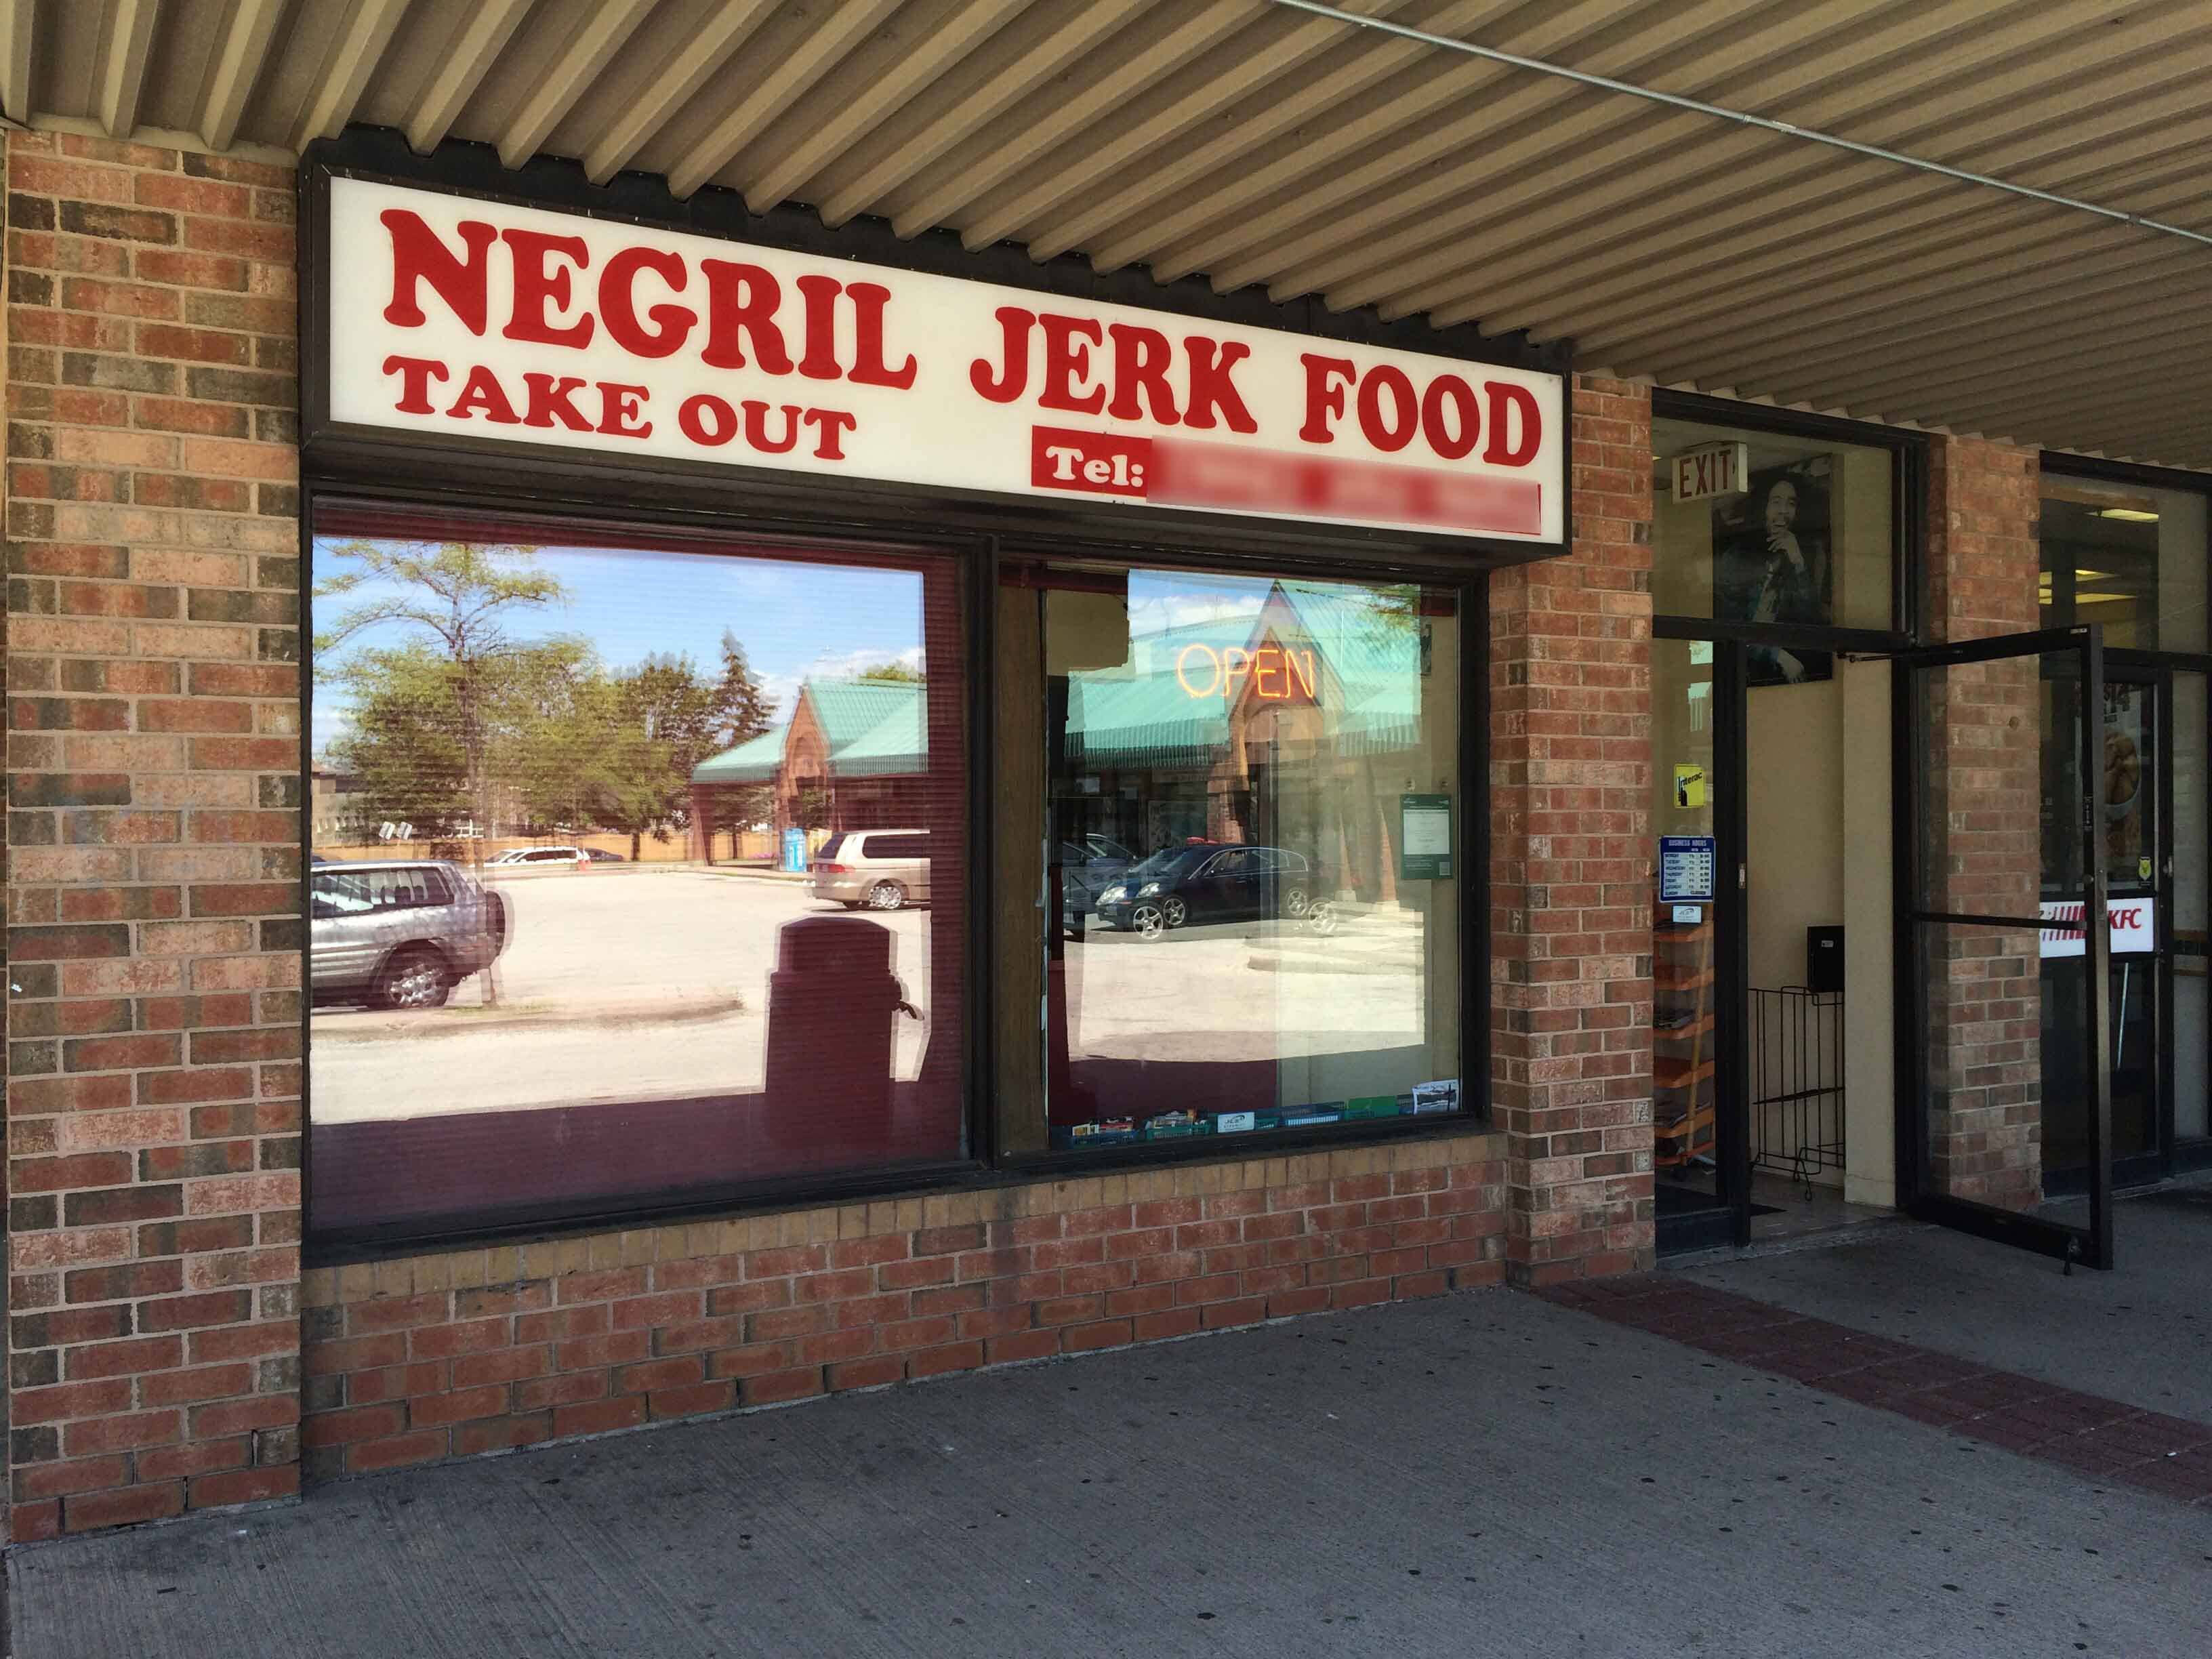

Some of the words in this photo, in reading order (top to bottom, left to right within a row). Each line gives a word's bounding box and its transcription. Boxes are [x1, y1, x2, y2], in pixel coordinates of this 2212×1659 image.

[380, 209, 918, 390] NEGRIL
[970, 306, 1258, 434] JERK
[1299, 353, 1541, 467] FOOD
[383, 355, 652, 438] TAKE
[678, 394, 857, 460] OUT
[1046, 446, 1144, 487] Tel:
[1680, 450, 1731, 498] EXIT
[1177, 644, 1315, 699] OPEN
[2109, 908, 2142, 930] KFC
